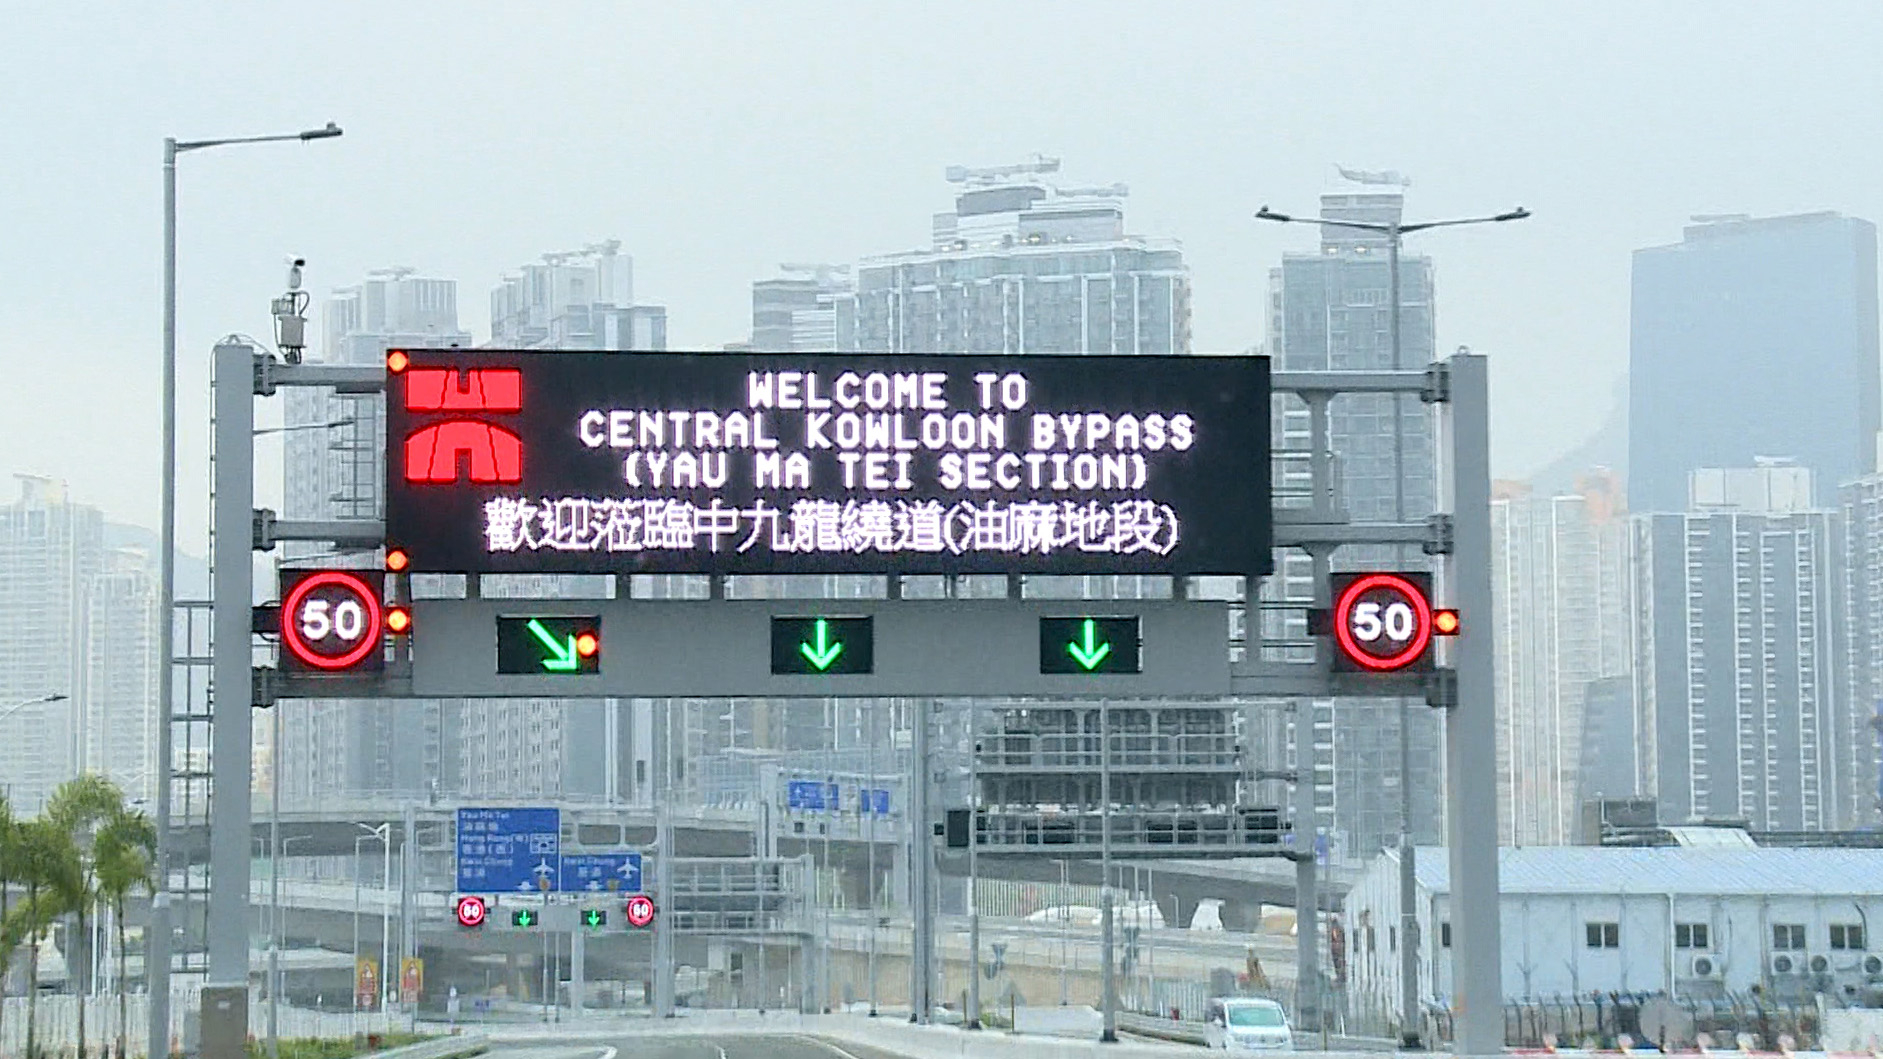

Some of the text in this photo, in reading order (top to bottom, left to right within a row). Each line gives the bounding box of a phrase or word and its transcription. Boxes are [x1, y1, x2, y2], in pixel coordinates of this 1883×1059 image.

[748, 371, 1029, 410] WELCOME TO
[579, 411, 1195, 451] CENTRAL KOWLOON BYPASS
[623, 451, 1149, 490] (YAU MA TEI SECTION)
[302, 600, 362, 640] 50
[1353, 603, 1413, 641] 50
